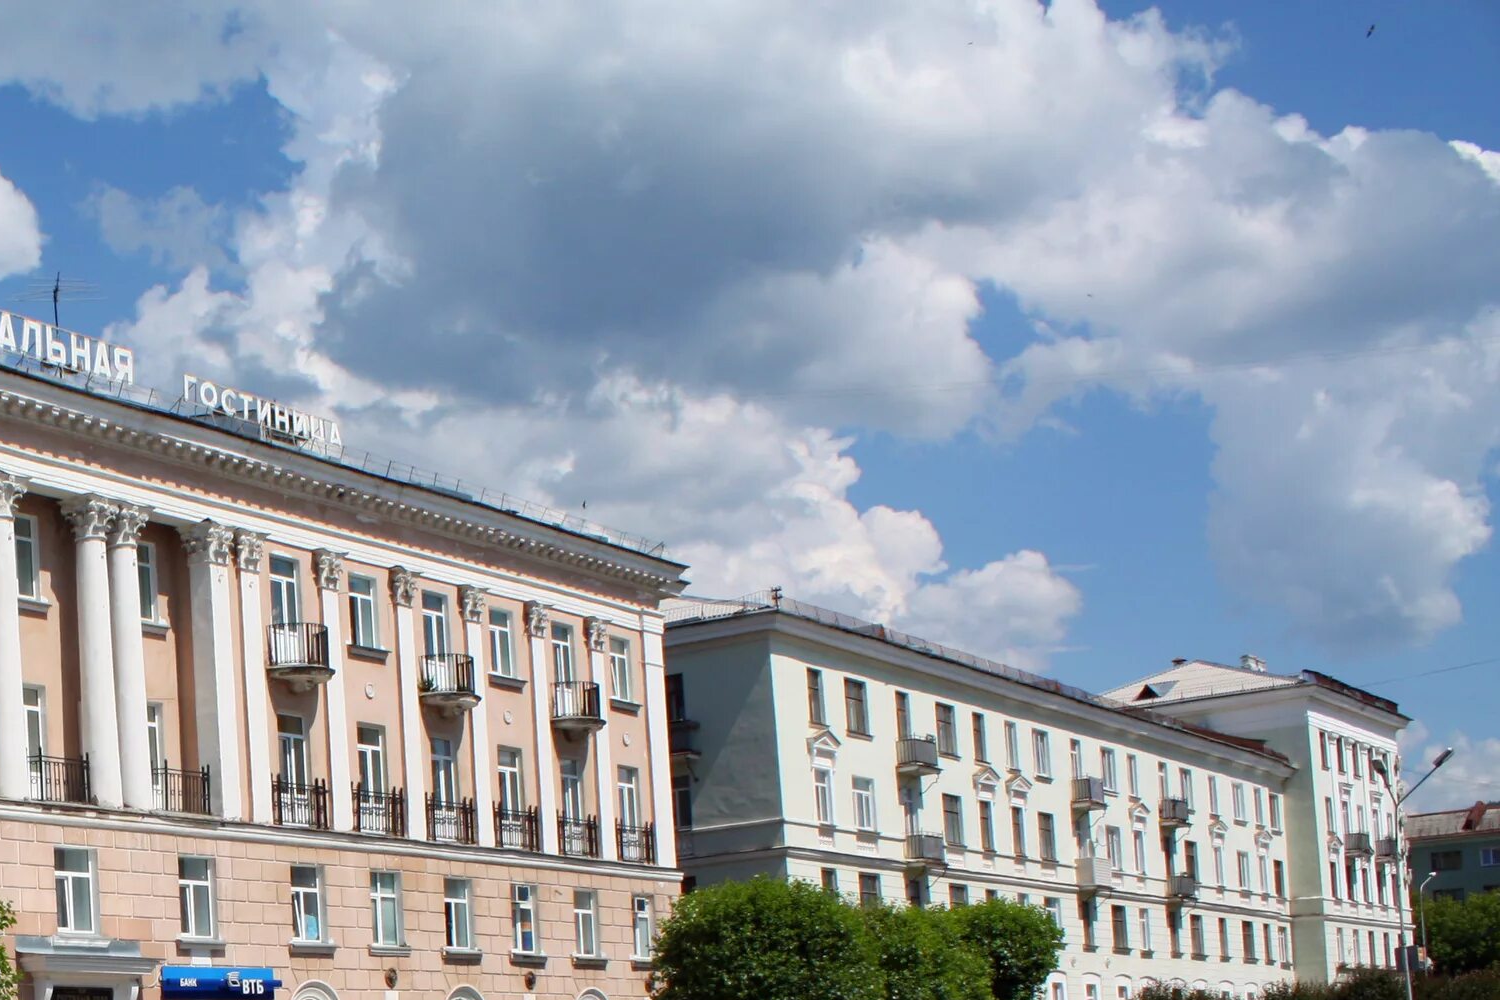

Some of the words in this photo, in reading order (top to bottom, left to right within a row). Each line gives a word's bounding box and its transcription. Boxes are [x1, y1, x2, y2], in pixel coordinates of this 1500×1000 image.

[183, 373, 342, 446] ГОСТИНИЦА
[180, 978, 197, 988] БАНК
[242, 979, 264, 995] ВТБ
